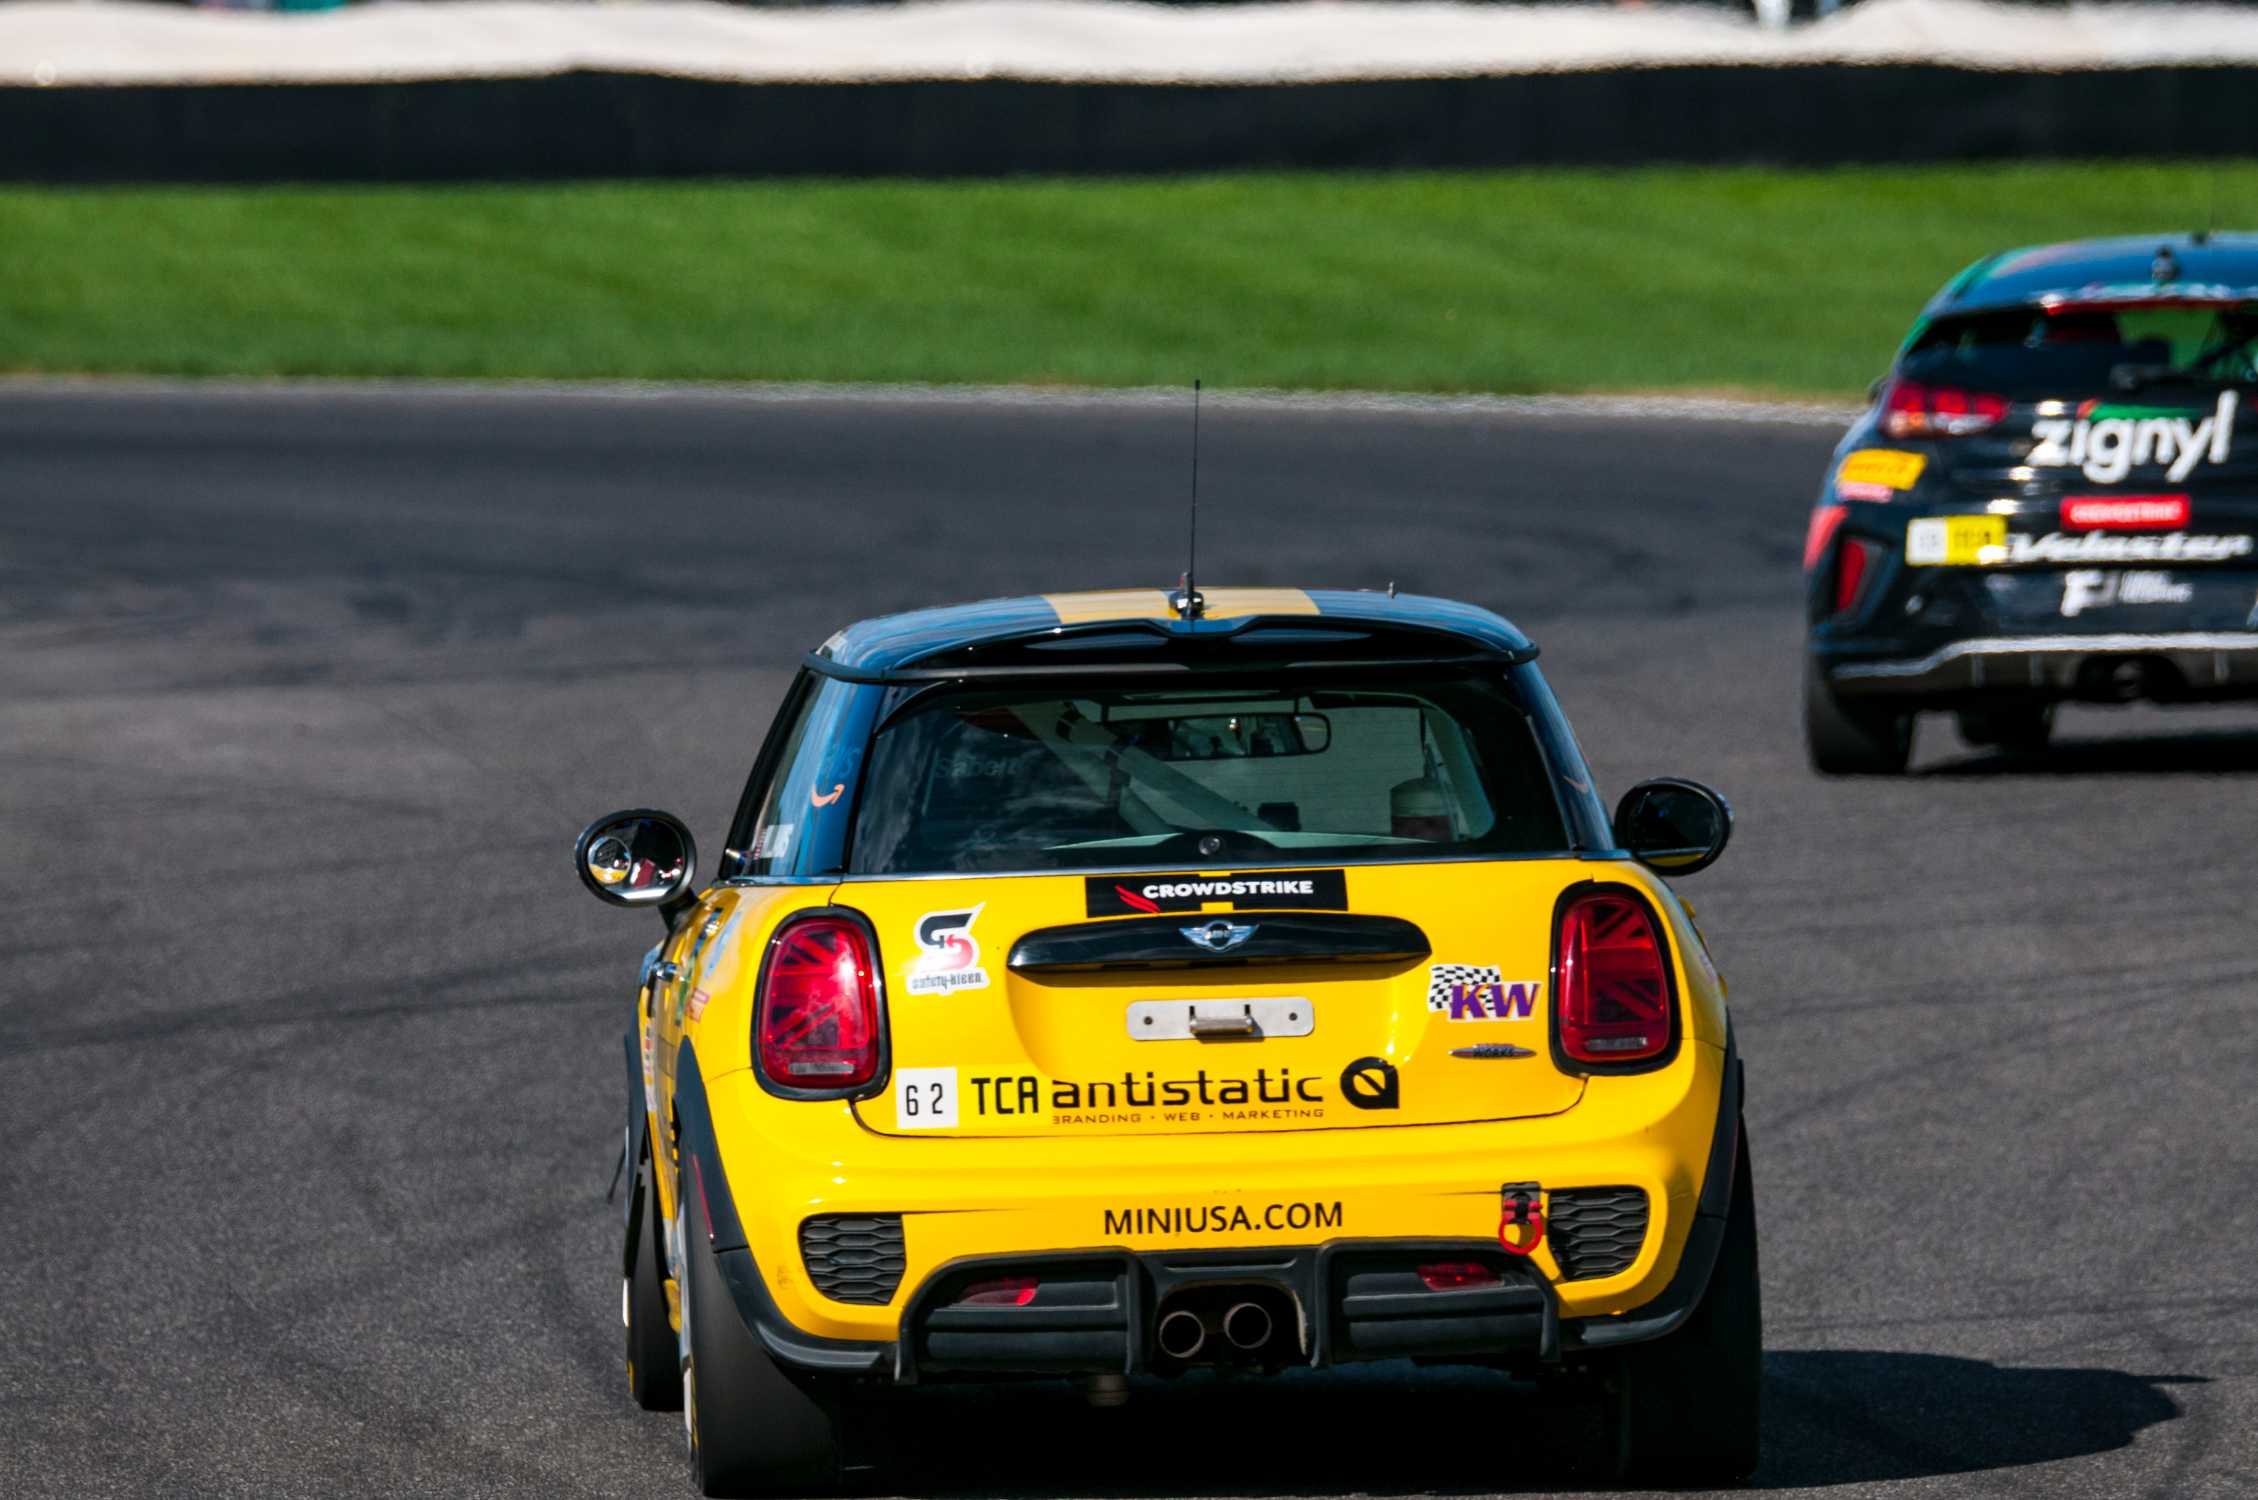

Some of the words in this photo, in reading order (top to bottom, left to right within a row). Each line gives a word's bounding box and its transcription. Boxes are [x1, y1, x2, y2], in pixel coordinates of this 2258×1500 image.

[2023, 388, 2240, 484] zignyl
[1142, 880, 1314, 899] CROWDSTRIKE
[1451, 983, 1541, 1020] KW
[971, 1076, 1039, 1115] TCA
[1052, 1068, 1324, 1109] antistatic
[1164, 1112, 1200, 1122] WEB
[1222, 1108, 1324, 1120] MARKETING
[1103, 1201, 1343, 1235] MINIUSA.COM
